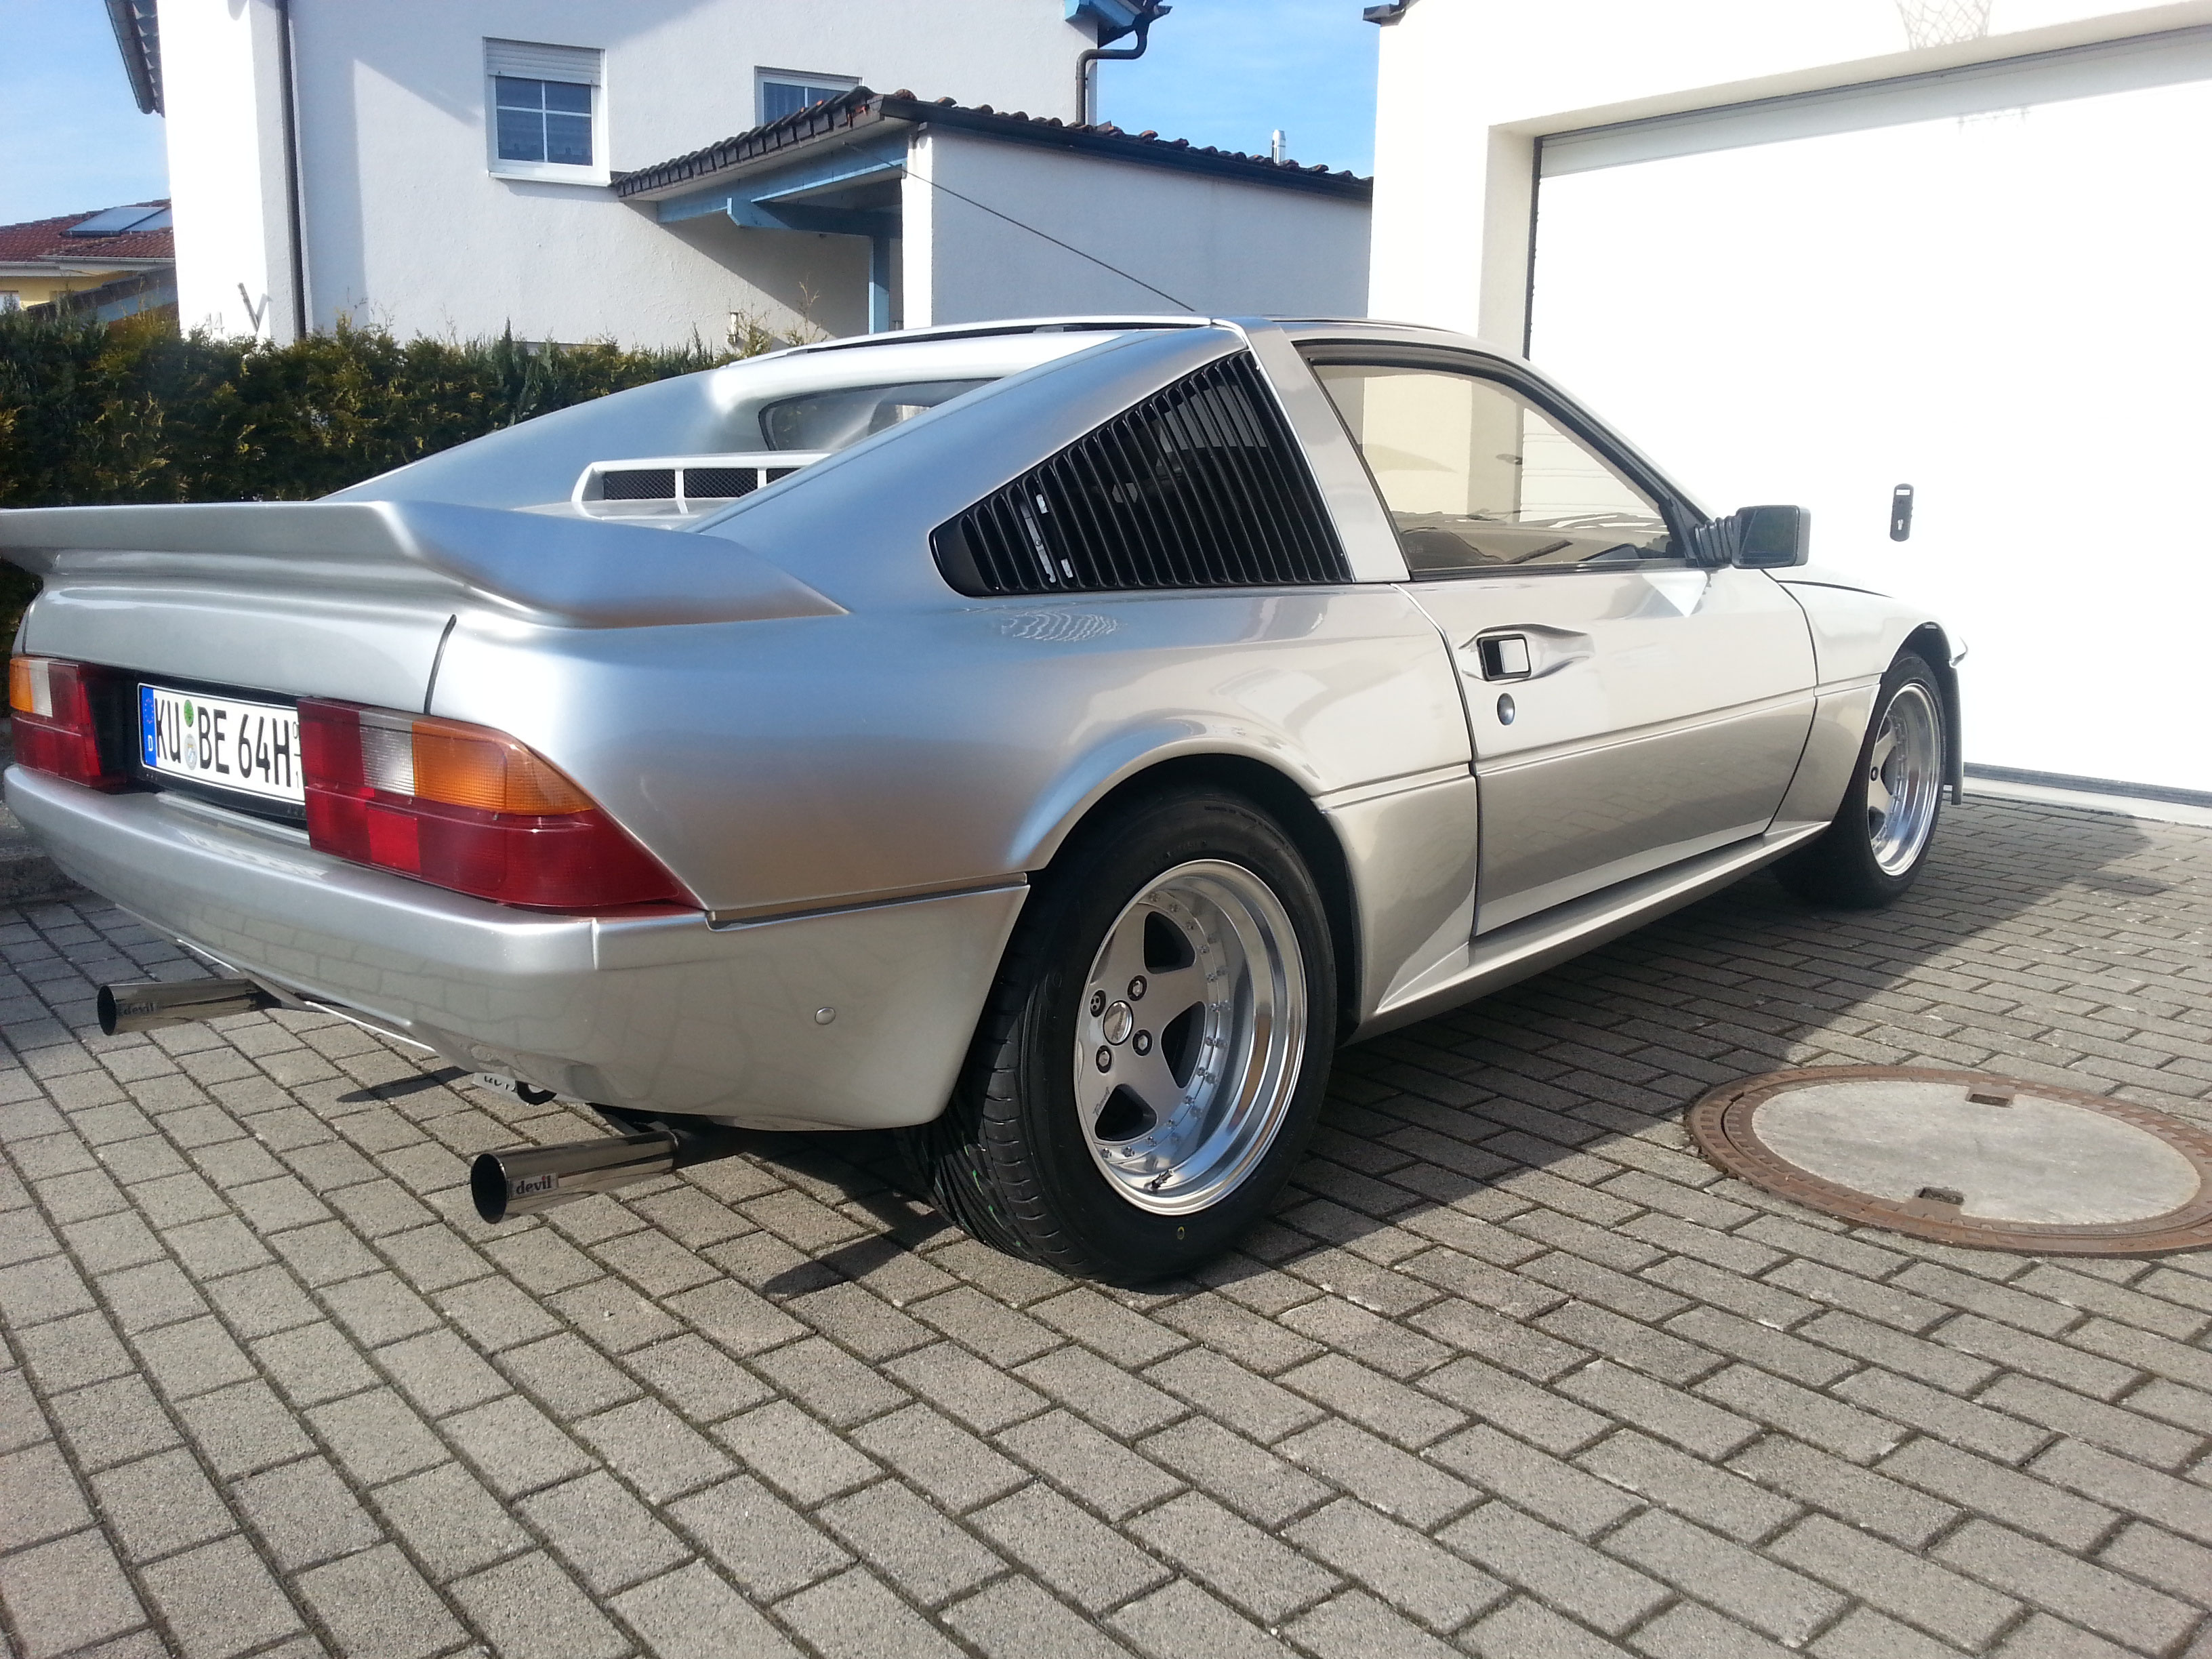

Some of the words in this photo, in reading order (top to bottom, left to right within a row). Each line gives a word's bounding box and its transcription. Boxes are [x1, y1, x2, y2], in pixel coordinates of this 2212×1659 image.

[148, 734, 154, 752] D
[155, 698, 181, 764] KU
[197, 706, 230, 775] BE
[238, 714, 291, 787] 64H
[124, 1002, 155, 1015] devil
[516, 1175, 552, 1195] devil
